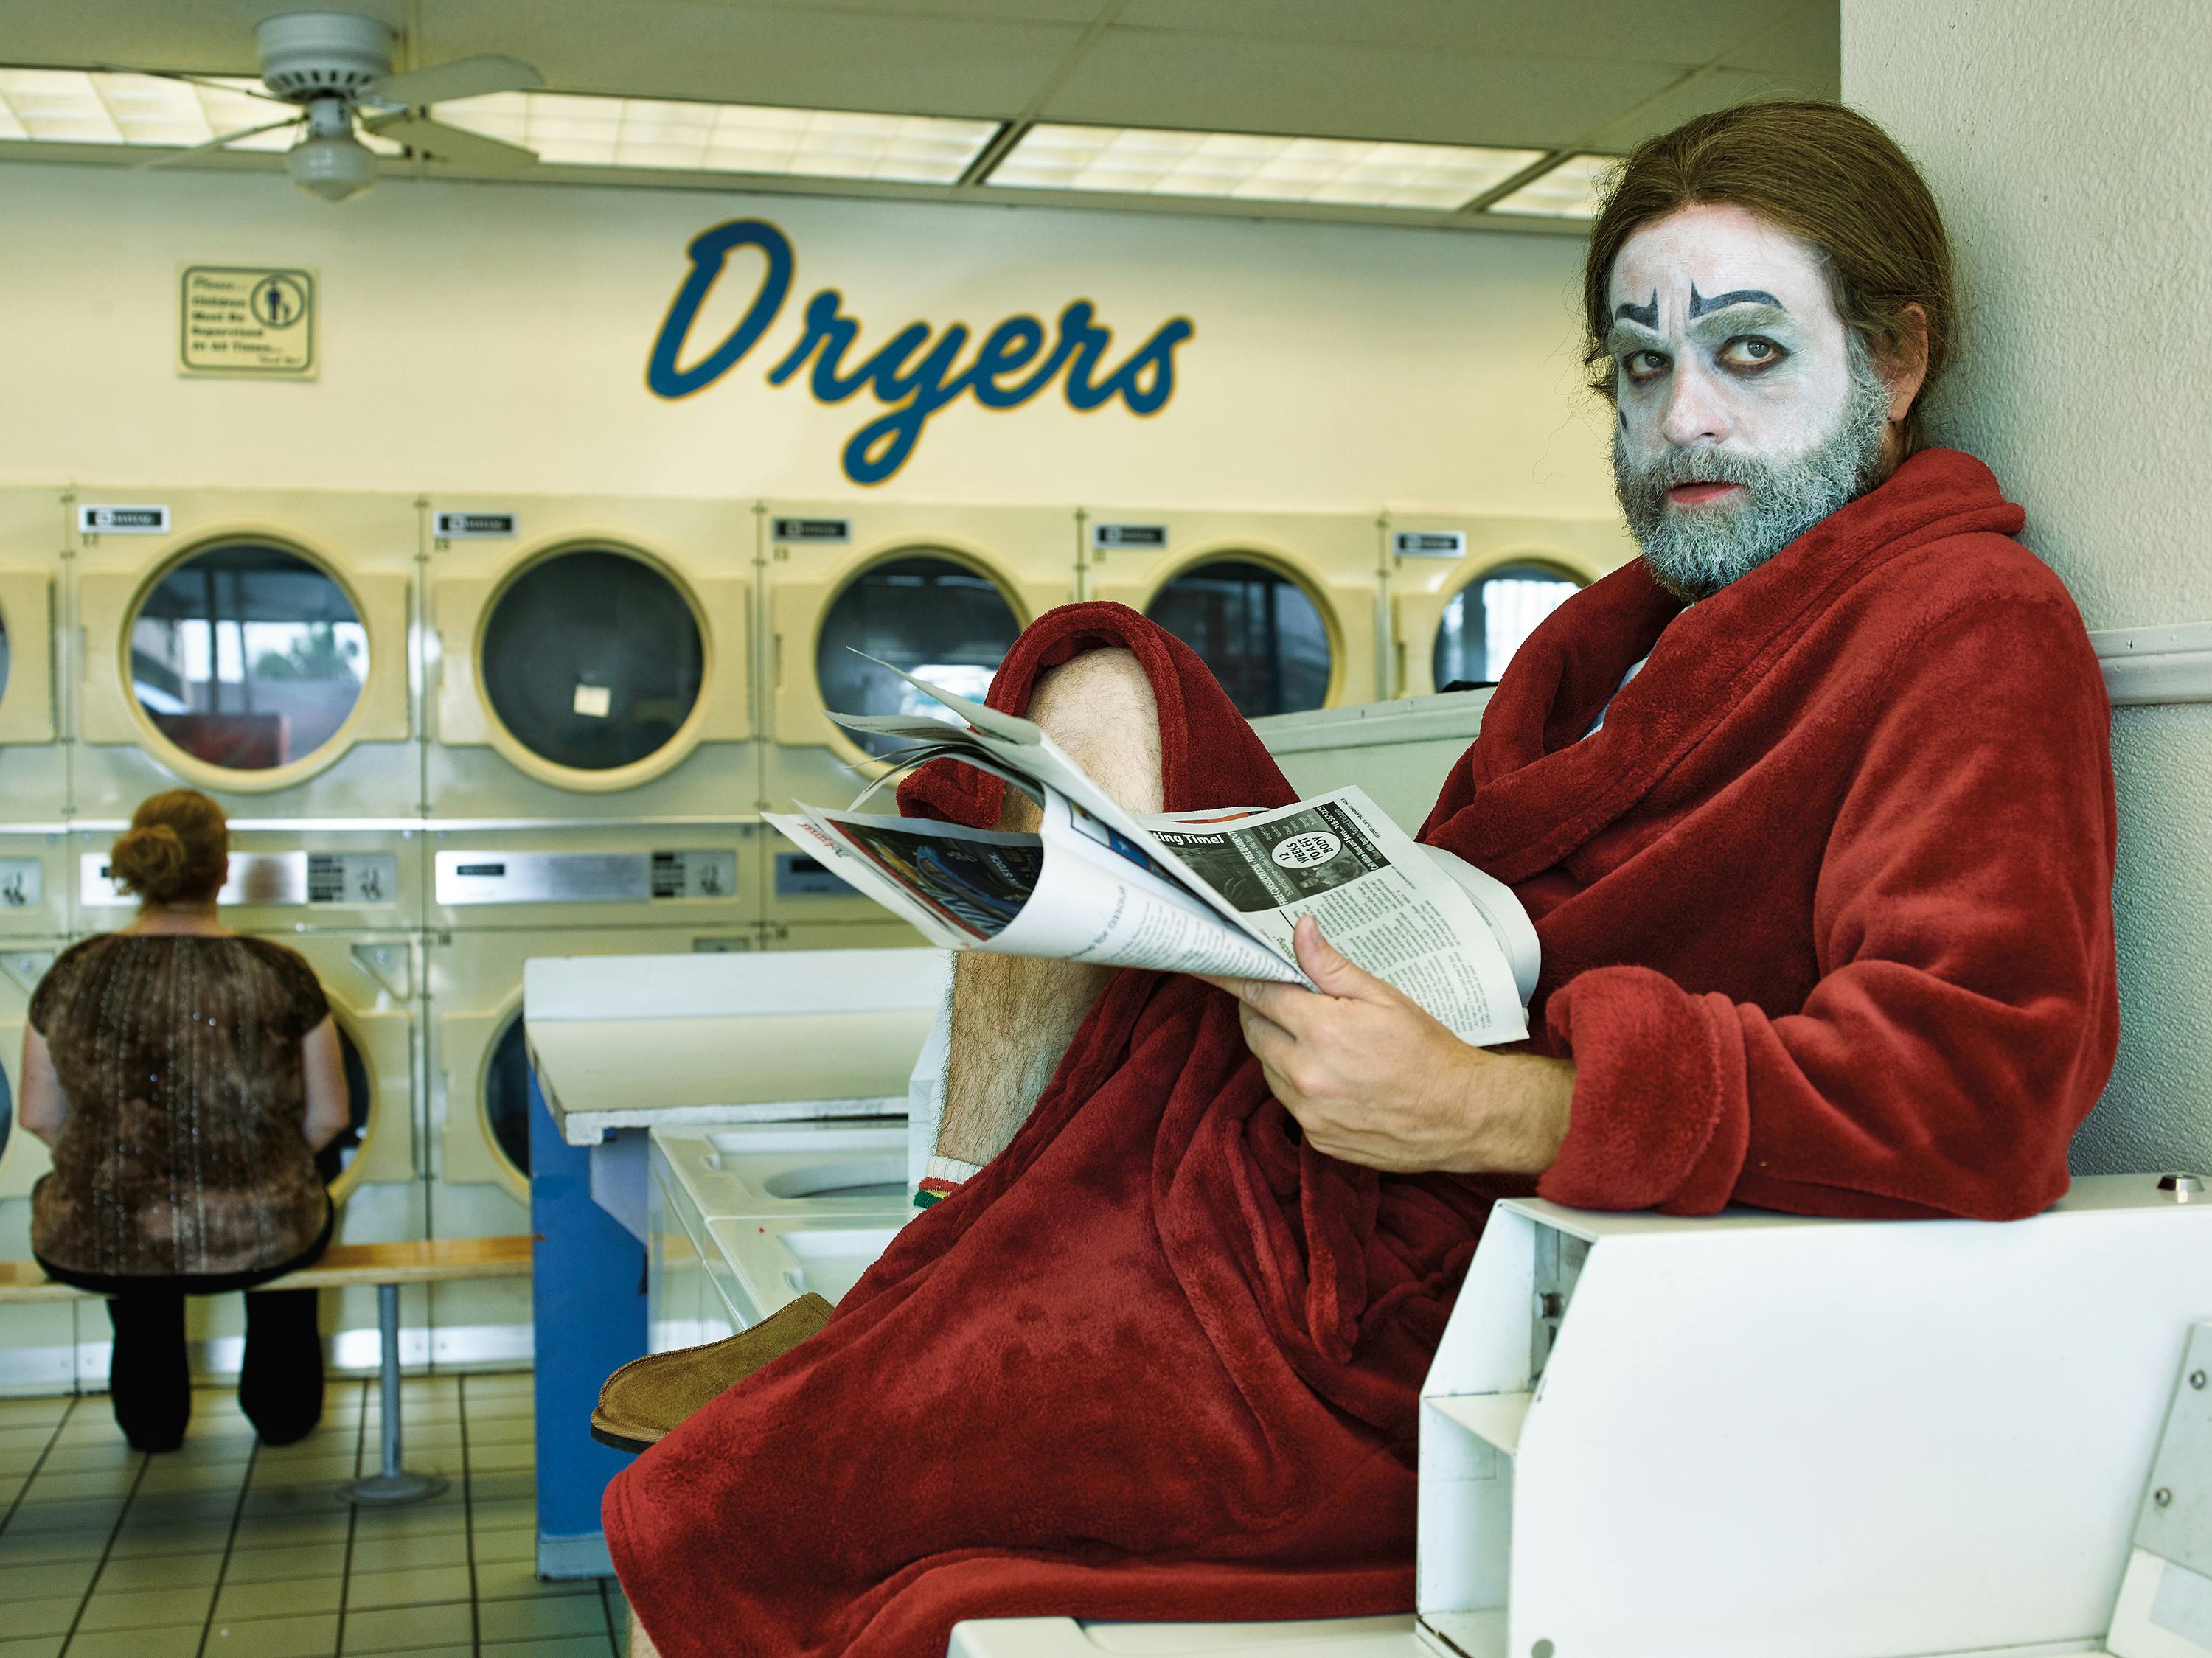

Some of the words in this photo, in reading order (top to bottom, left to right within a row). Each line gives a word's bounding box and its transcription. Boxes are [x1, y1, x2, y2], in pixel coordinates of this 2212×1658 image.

[645, 218, 1194, 485] Dryers
[1182, 834, 1225, 844] Time!
[1226, 830, 1250, 852] WORKOUT
[1296, 836, 1312, 847] FIT
[1311, 835, 1334, 854] BODY
[1345, 838, 1357, 848] and
[1285, 842, 1310, 863] WEEKS
[1308, 851, 1324, 861] TO
[1352, 846, 1365, 855] Now
[1242, 851, 1257, 863] FREE
[1278, 852, 1292, 861] 12
[1358, 853, 1373, 864] Mike
[1366, 861, 1379, 871] Call
[1250, 863, 1281, 895] CONSULTATION
[1273, 893, 1288, 905] FREE
